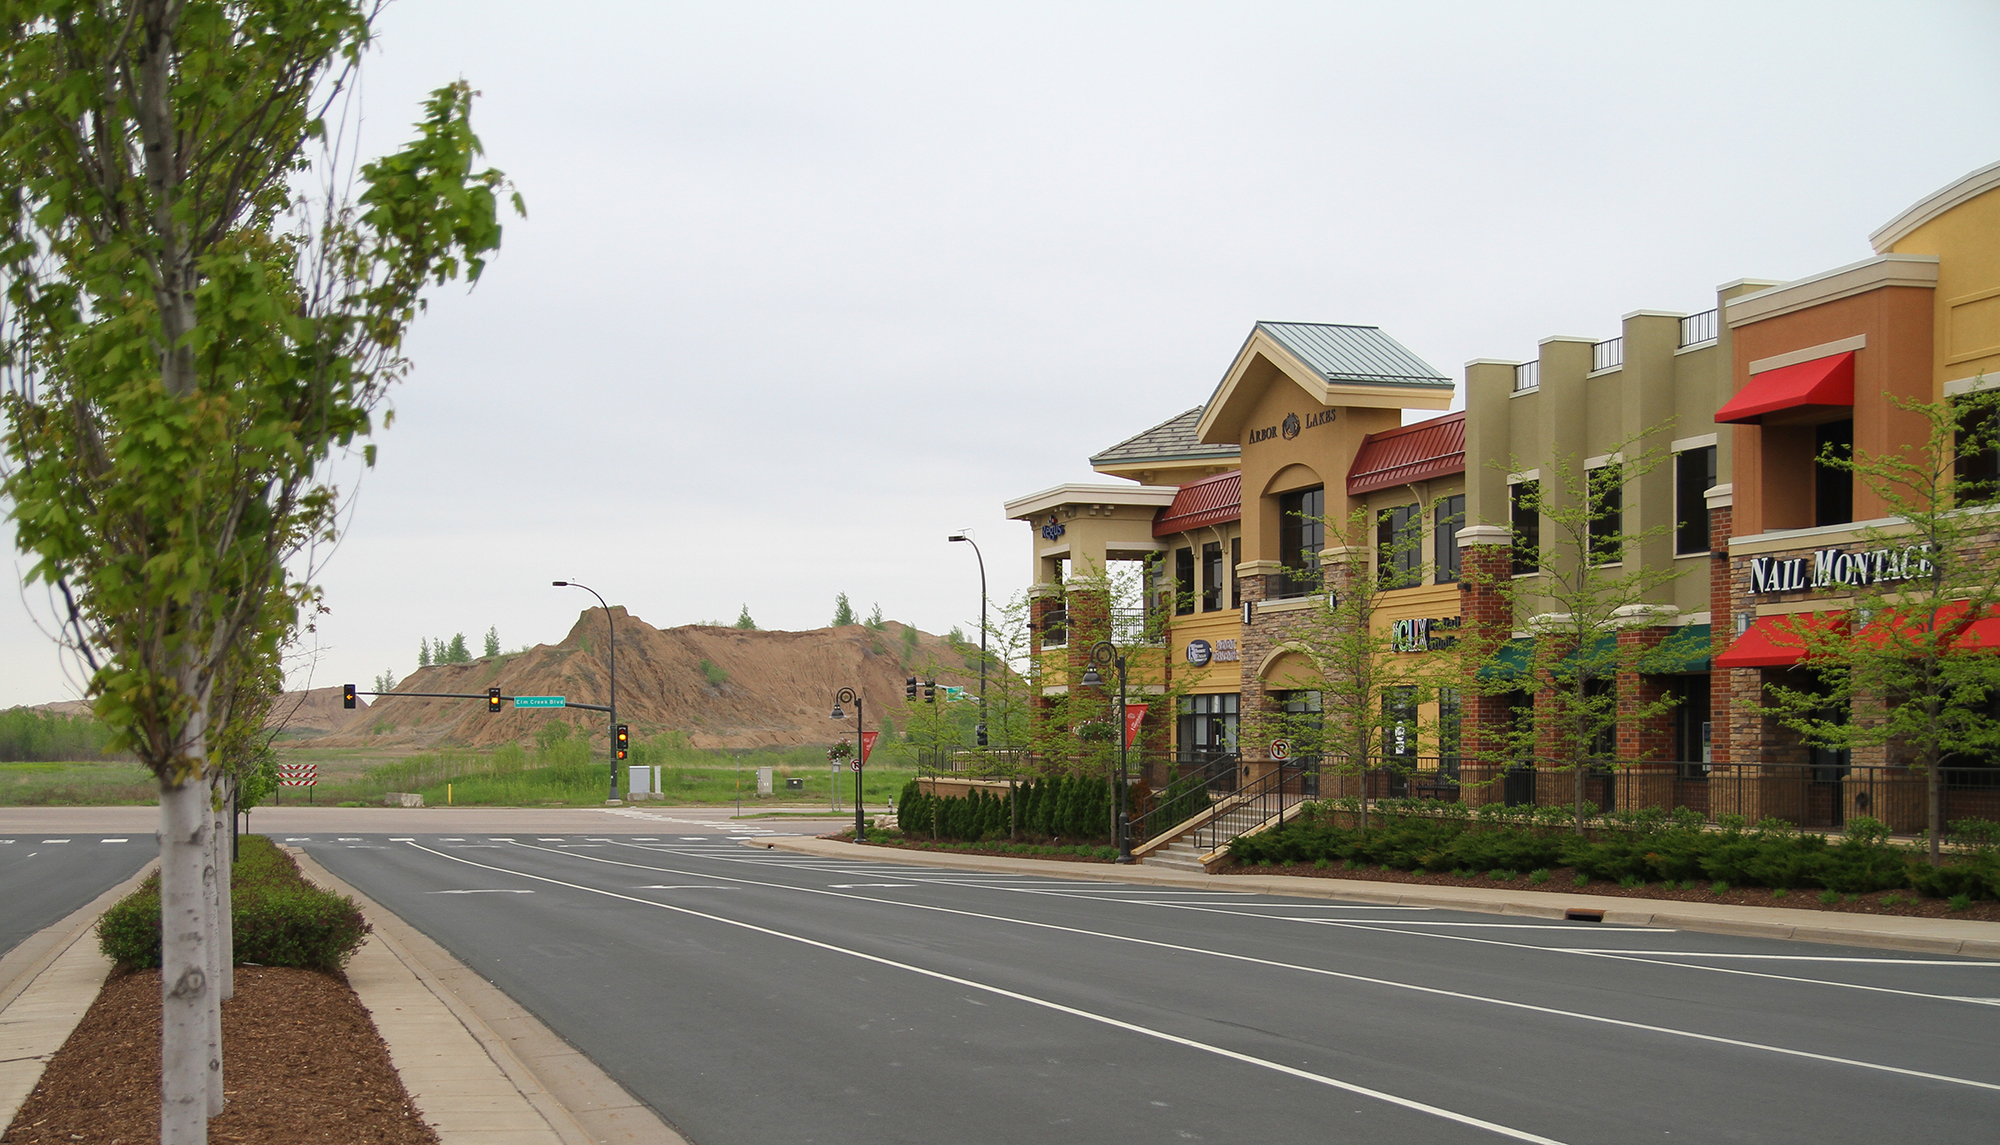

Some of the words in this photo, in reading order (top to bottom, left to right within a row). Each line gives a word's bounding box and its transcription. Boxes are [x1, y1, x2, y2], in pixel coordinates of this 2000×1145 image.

[1249, 426, 1278, 445] ARBOR
[1305, 408, 1336, 429] LAKES
[1042, 524, 1066, 541] Regus
[1748, 557, 1806, 594] NAIL
[1428, 616, 1461, 631] Potrait
